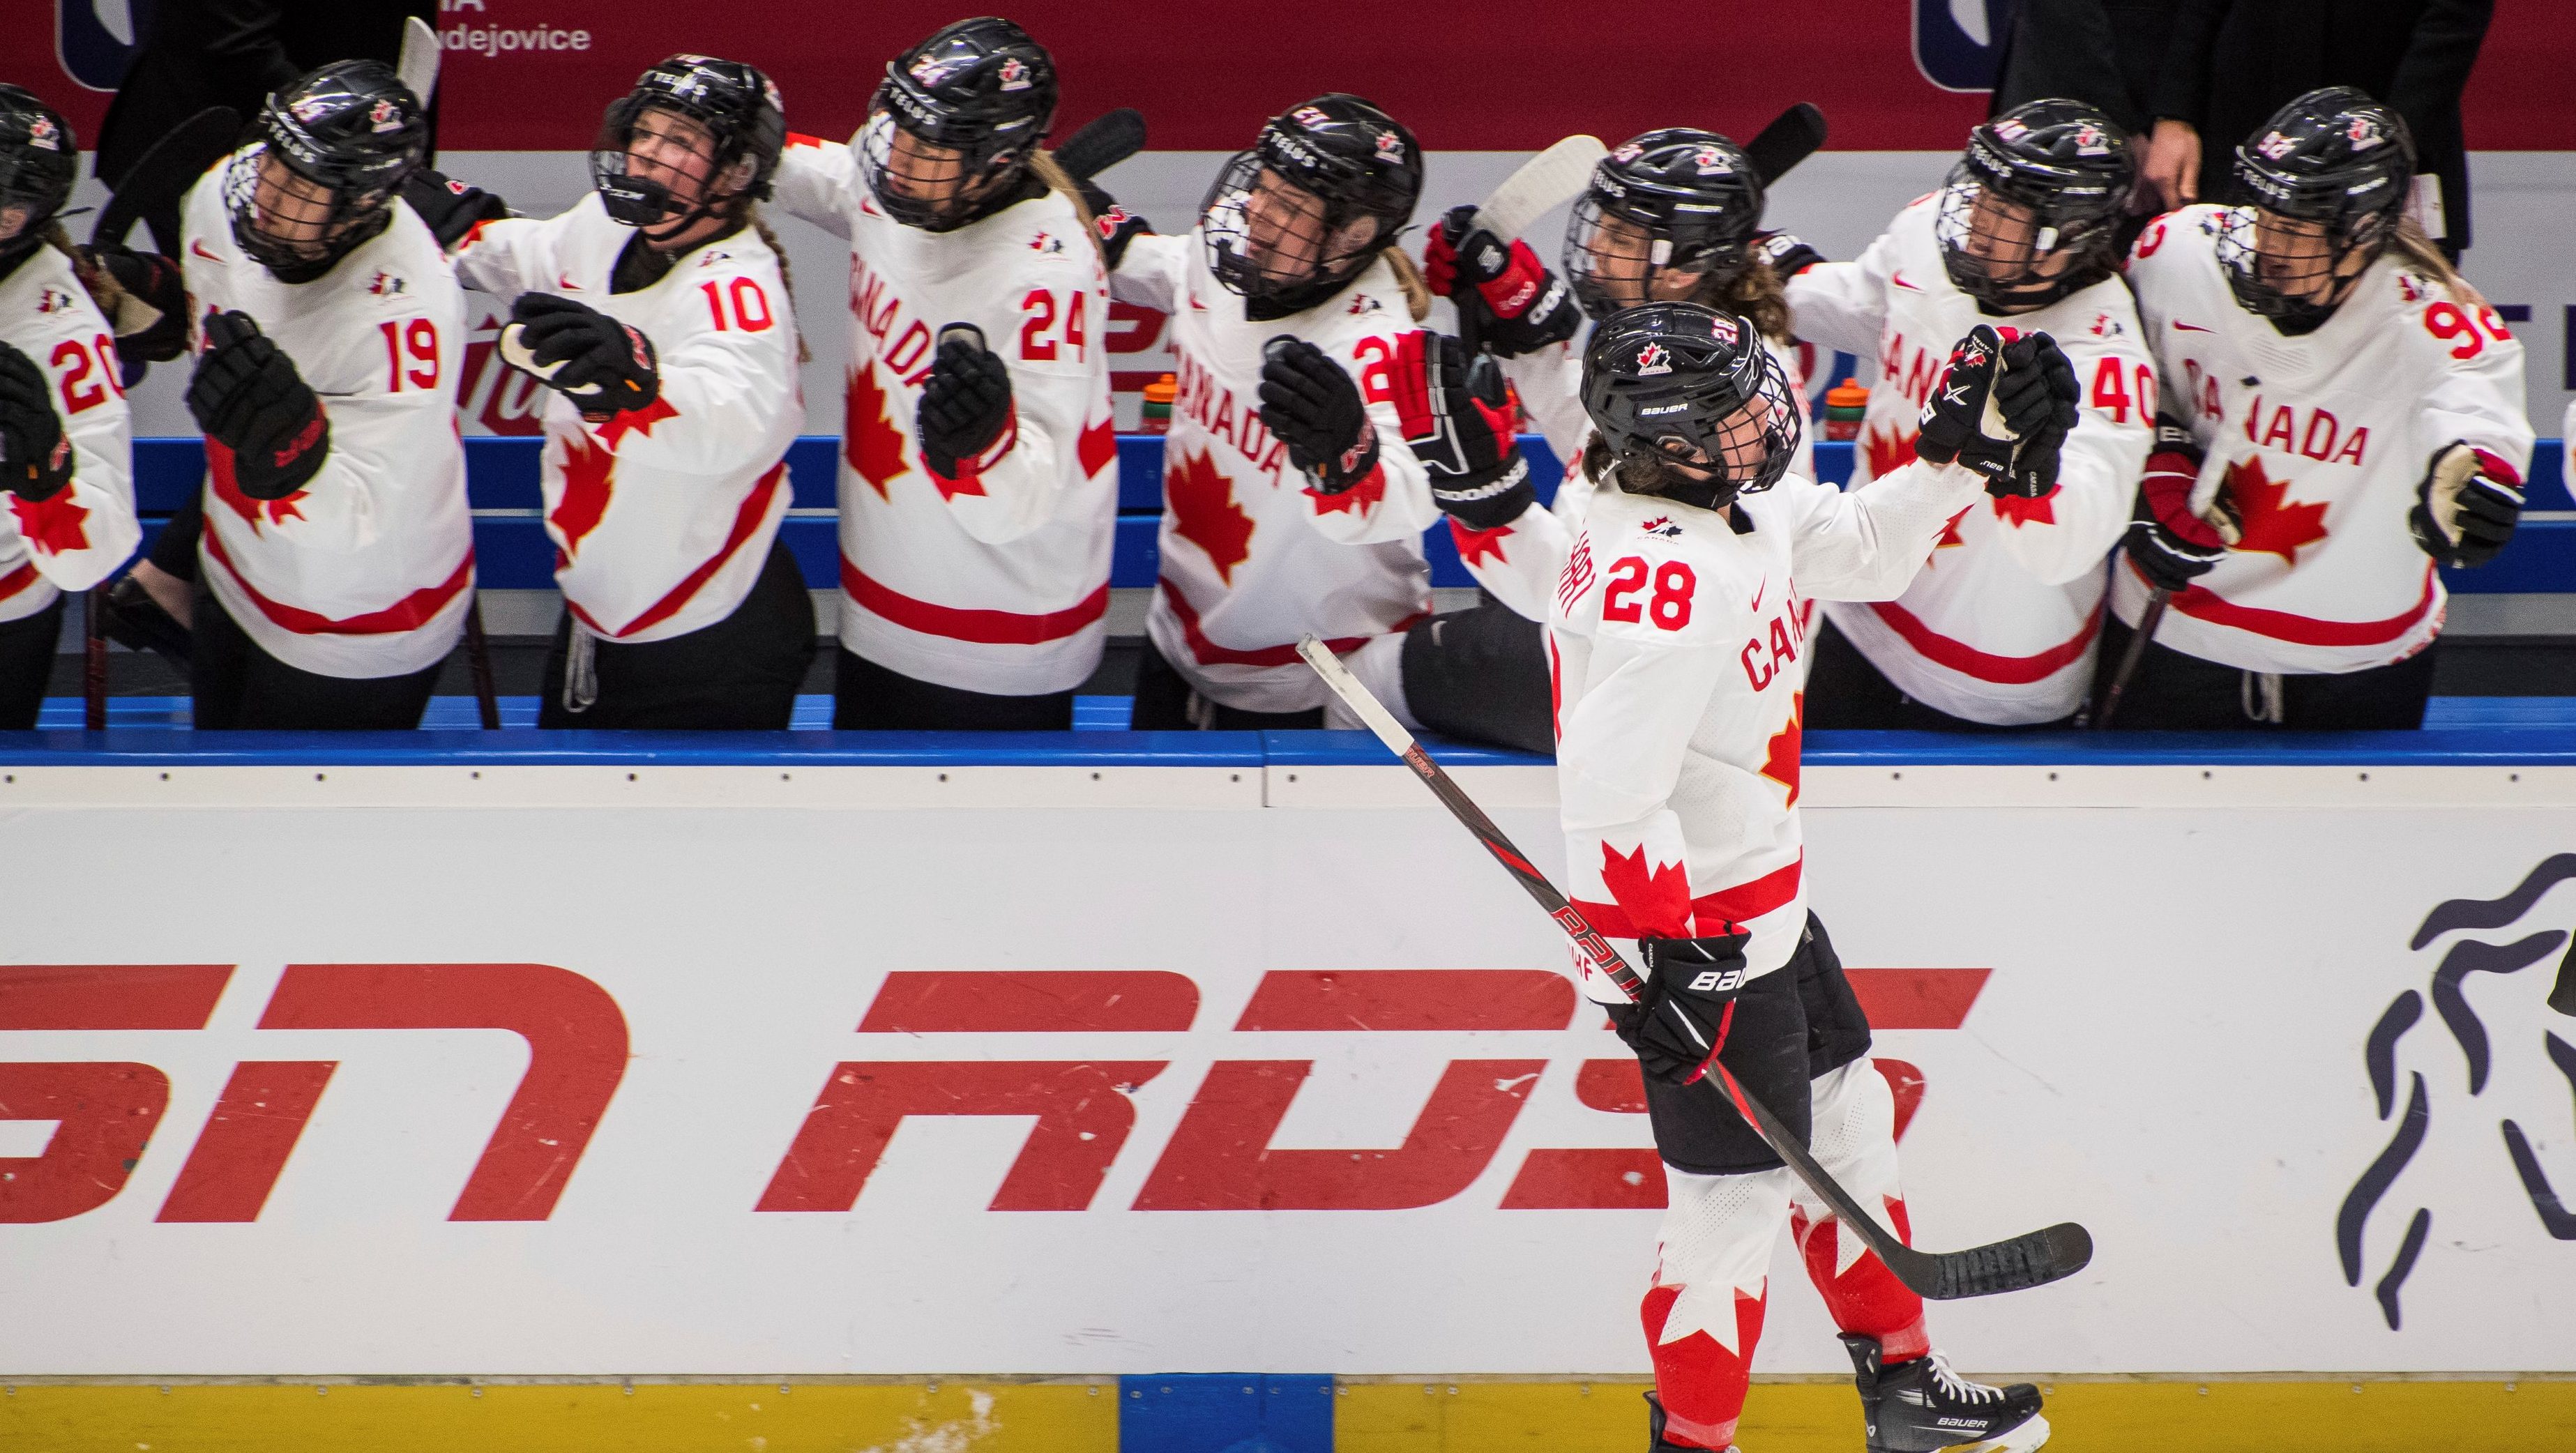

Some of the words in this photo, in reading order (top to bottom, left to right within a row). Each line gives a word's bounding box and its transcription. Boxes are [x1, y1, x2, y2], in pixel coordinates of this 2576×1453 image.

[699, 276, 774, 333] 10
[1020, 289, 1087, 362] 24
[380, 318, 439, 393] 19
[1641, 403, 1688, 416] BAUER
[2092, 356, 2158, 429] 40
[1603, 556, 1697, 632] 28
[1741, 576, 1805, 692] CAN
[1937, 1417, 1989, 1429] BAUER
